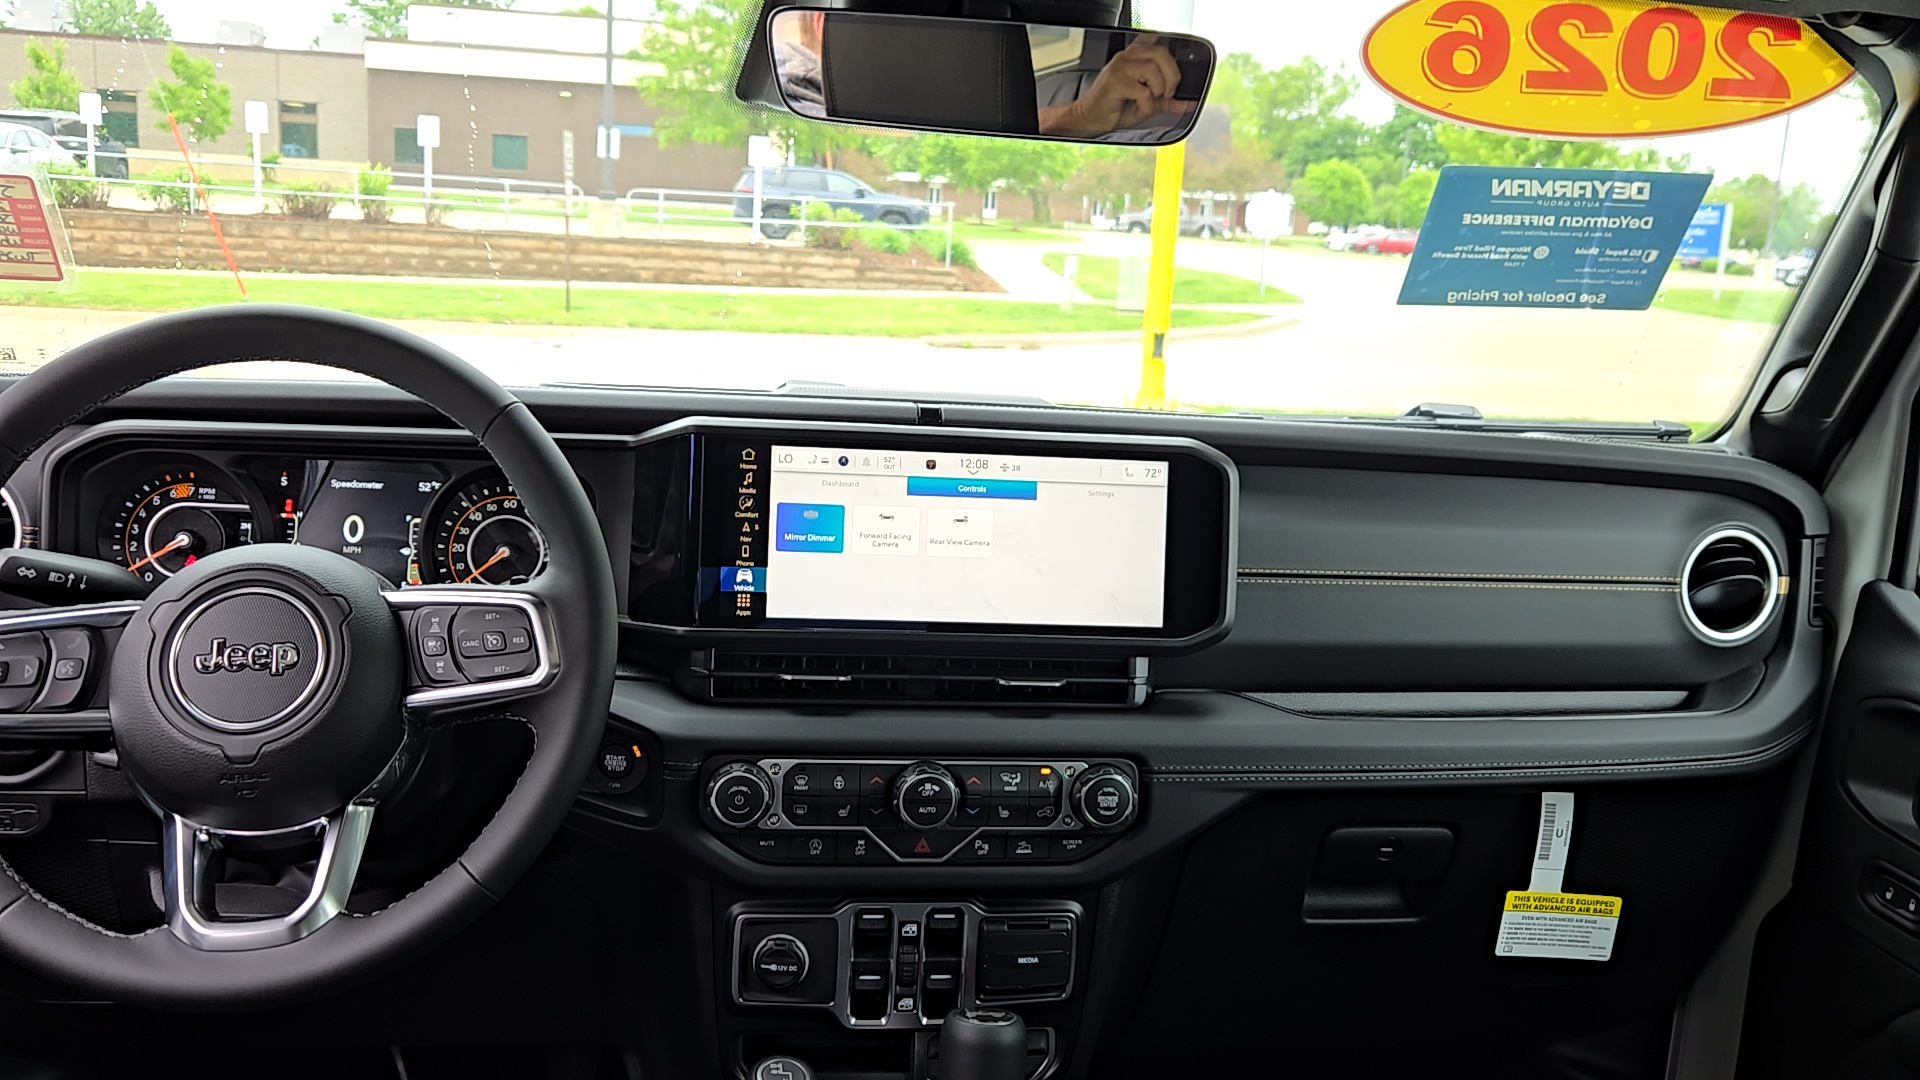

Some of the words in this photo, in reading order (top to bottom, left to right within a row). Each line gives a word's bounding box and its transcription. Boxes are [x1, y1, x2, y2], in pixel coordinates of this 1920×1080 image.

[778, 454, 793, 464] LO
[960, 459, 988, 469] 12:08
[1145, 468, 1161, 478] 72°
[281, 476, 288, 487] S
[330, 478, 384, 490] Speedometer
[958, 484, 987, 493] Controls
[170, 489, 176, 498] 6
[1088, 489, 1114, 498] Settings
[153, 496, 161, 505] 5
[503, 499, 517, 509] 60
[486, 503, 498, 511] 50
[139, 509, 147, 518] 4
[469, 512, 482, 521] 40
[131, 524, 139, 534] 3
[342, 514, 365, 543] 0
[459, 527, 470, 535] 30
[784, 533, 807, 541] Mirror
[808, 534, 837, 542] Dimmer
[889, 533, 912, 541] Facing
[130, 541, 138, 552] 2
[343, 545, 361, 554] MPH
[451, 543, 465, 552] 20
[455, 562, 465, 570] 10
[144, 571, 153, 581] 0
[736, 609, 751, 617] Apps
[194, 637, 300, 677] Jeep
[1039, 780, 1054, 788] A/C
[1556, 828, 1564, 838] U
[1513, 895, 1531, 903] THIS
[1532, 896, 1565, 904] VEHICLE
[1575, 898, 1616, 907] EQUIPPED
[1533, 904, 1576, 912] ADVANCED
[1592, 907, 1614, 915] BAGS
[1017, 956, 1039, 964] MEDIA
